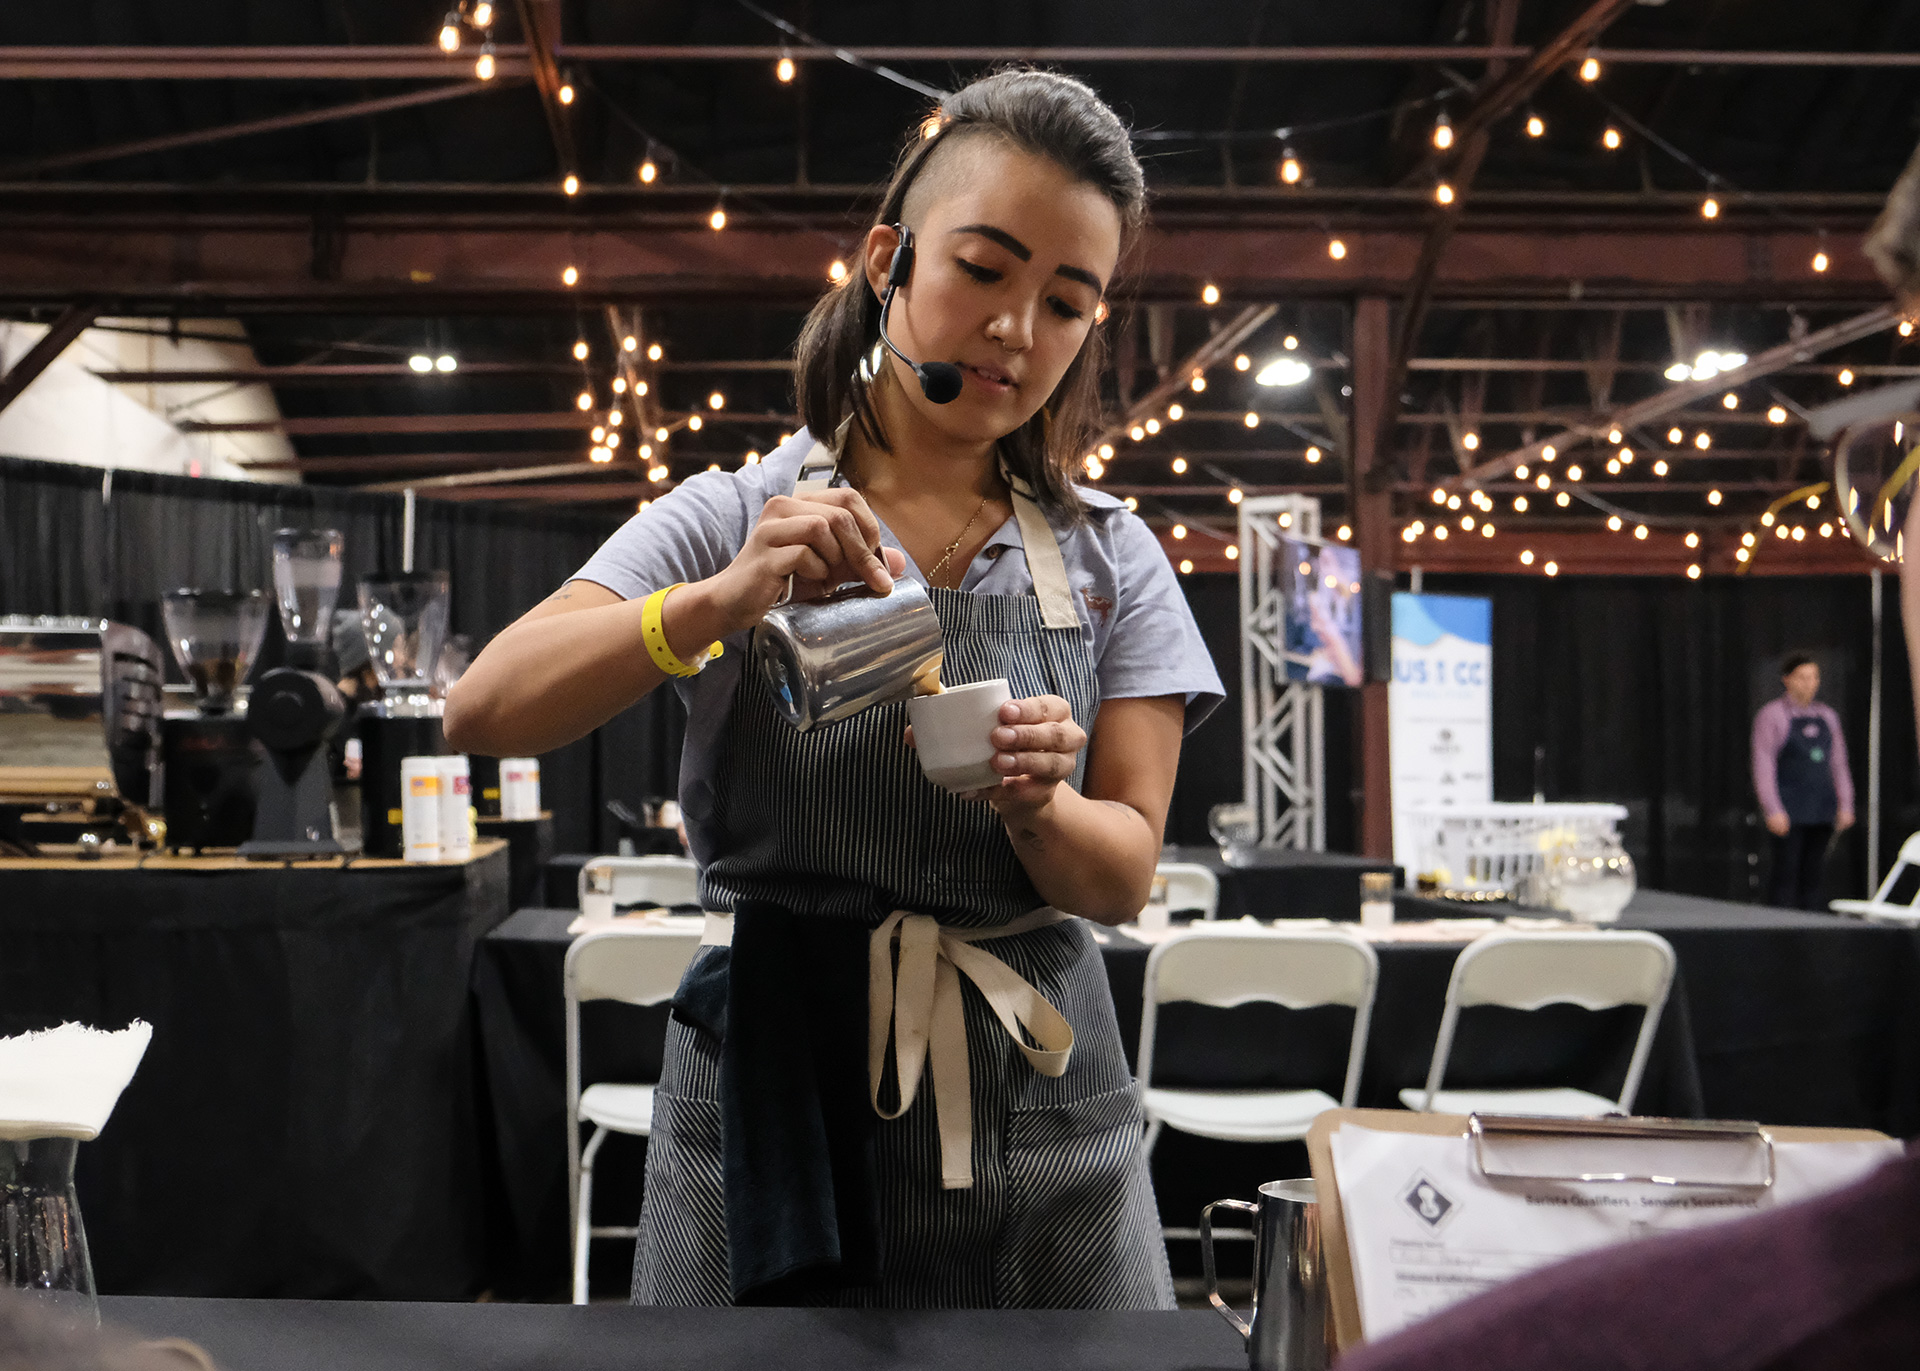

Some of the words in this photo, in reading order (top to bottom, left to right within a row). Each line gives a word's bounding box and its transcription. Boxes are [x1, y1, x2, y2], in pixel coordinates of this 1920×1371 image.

[1525, 1194, 1567, 1207] Barista
[1571, 1194, 1630, 1207] Qualifiers
[1640, 1195, 1688, 1209] Sensory
